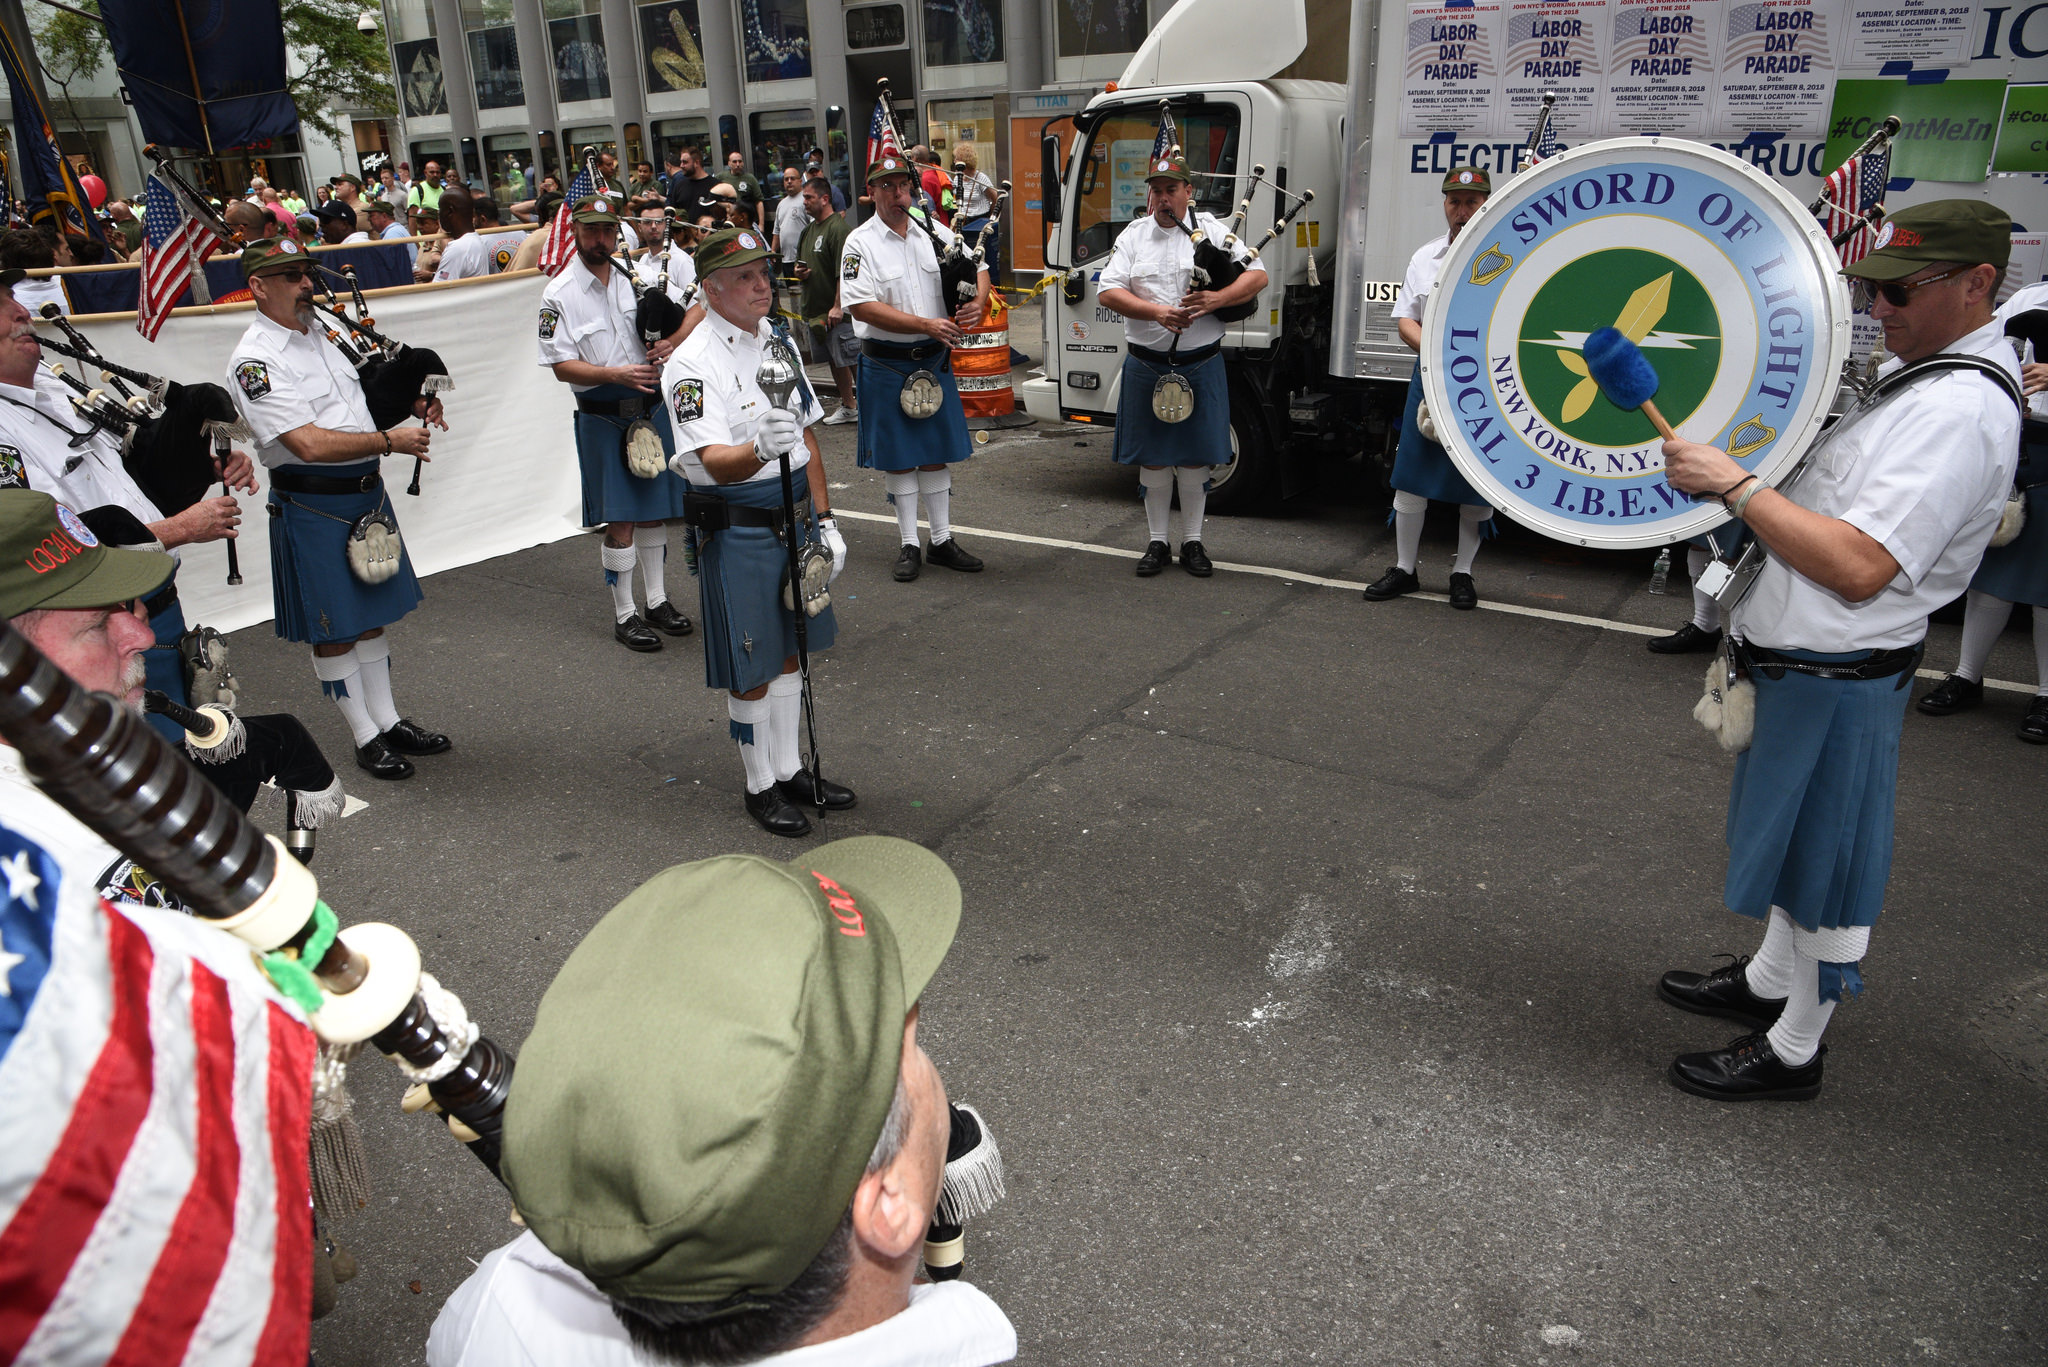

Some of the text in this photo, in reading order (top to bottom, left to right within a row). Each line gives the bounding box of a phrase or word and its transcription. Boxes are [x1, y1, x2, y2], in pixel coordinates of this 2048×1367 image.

[1755, 11, 1814, 31] LABOR
[1856, 10, 1894, 18] SATURDAY,
[1895, 8, 1939, 17] SEPTEMBER
[1948, 7, 1969, 15] 2018
[1942, 17, 1962, 25] TIME:
[1430, 24, 1477, 42] LABOR
[1532, 20, 1582, 38] LABOR
[1640, 16, 1693, 34] LABOR
[1541, 41, 1569, 58] DAY
[1648, 37, 1679, 55] DAY
[1765, 34, 1799, 52] DAY
[1439, 44, 1466, 61] DAY
[1424, 63, 1478, 80] PARADE
[1524, 60, 1582, 78] PARADE
[1631, 58, 1693, 76] PARADE
[1745, 55, 1812, 74] PARADE
[1035, 96, 1068, 107] TITAN
[1832, 116, 1992, 141] #ContMeIn
[1411, 143, 1569, 174] ELECTR
[1511, 172, 1805, 410] SWORD OF LIGHT
[1096, 307, 1125, 324] RIDGE
[1450, 326, 1508, 464] LOCAL
[1514, 464, 1541, 490] 3
[1492, 354, 1659, 475] NEW YORK, N.Y.
[25, 527, 84, 574] LOCAL
